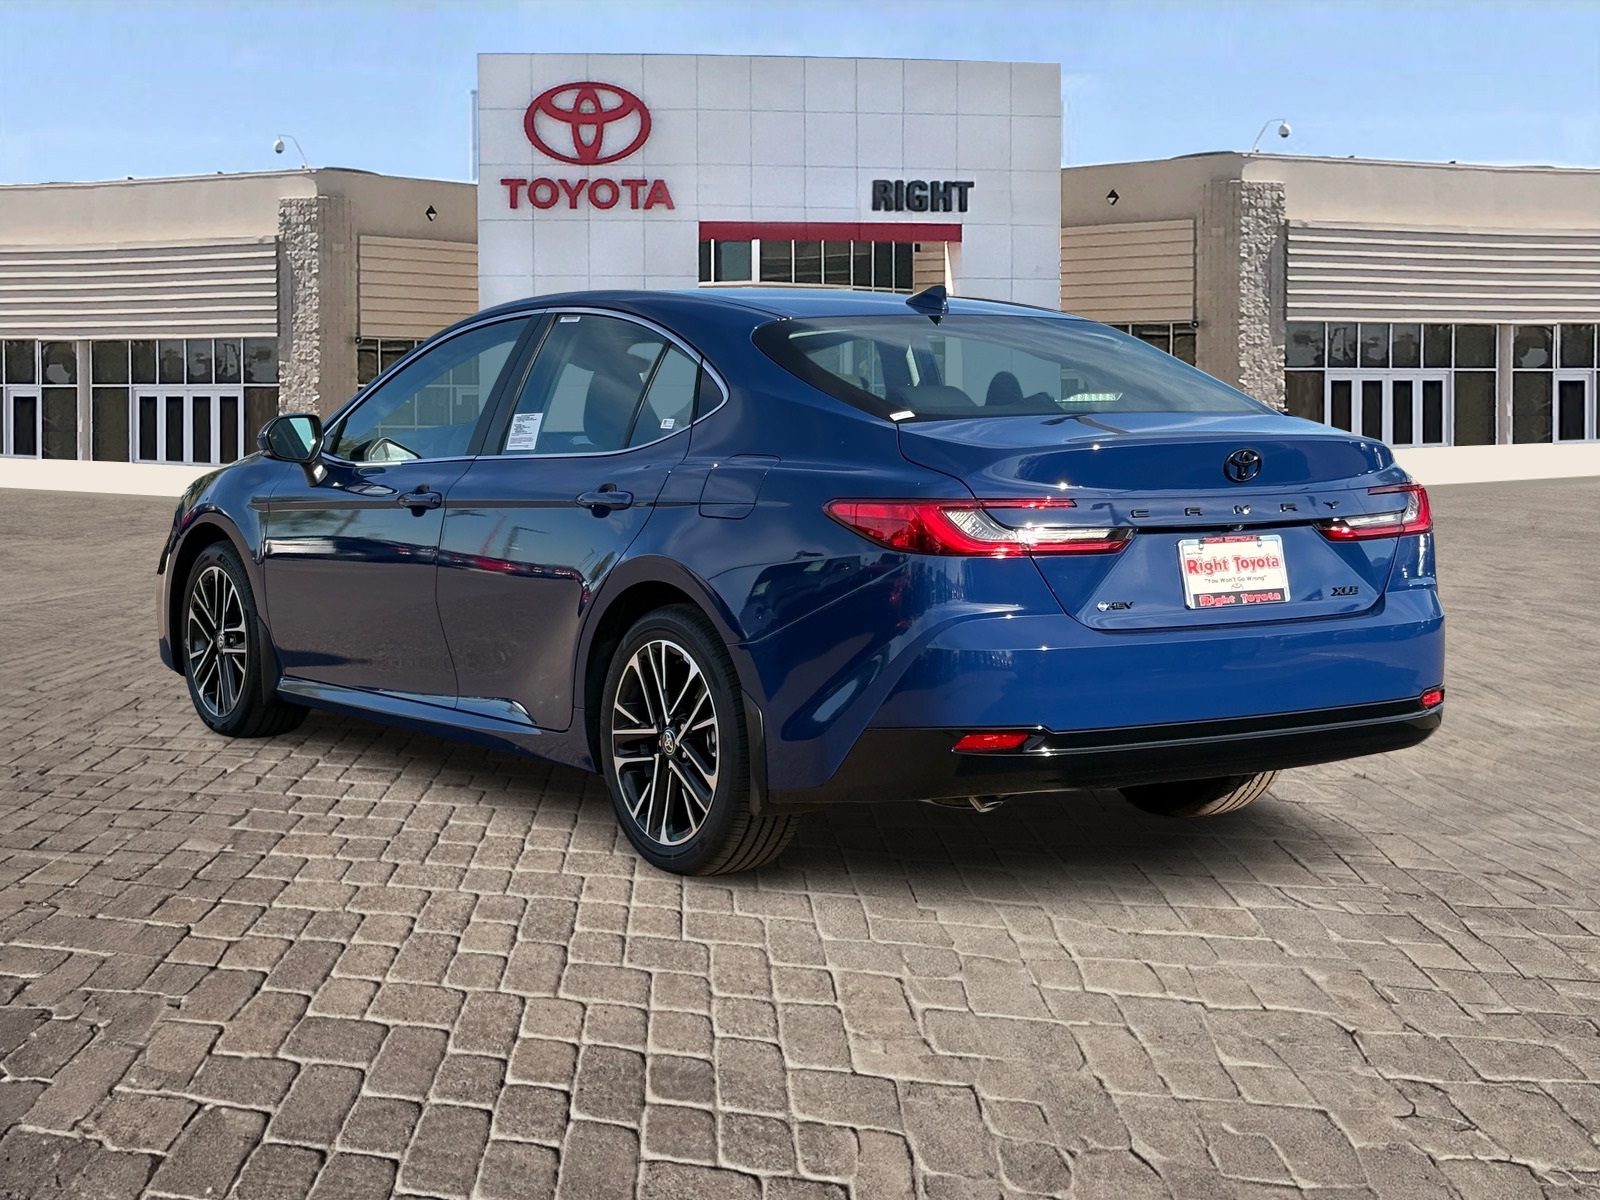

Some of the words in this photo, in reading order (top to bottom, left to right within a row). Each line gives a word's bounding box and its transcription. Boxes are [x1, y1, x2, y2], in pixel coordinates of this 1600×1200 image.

[500, 178, 675, 210] TOYOTA
[871, 179, 975, 213] RIGHT
[1131, 500, 1338, 518] CAMRY
[1186, 557, 1229, 576] Right
[1233, 555, 1280, 572] Toyota
[1199, 595, 1236, 607] Right
[1240, 592, 1281, 603] Toyota
[1331, 585, 1359, 597] XLE
[1107, 600, 1135, 610] HEV
